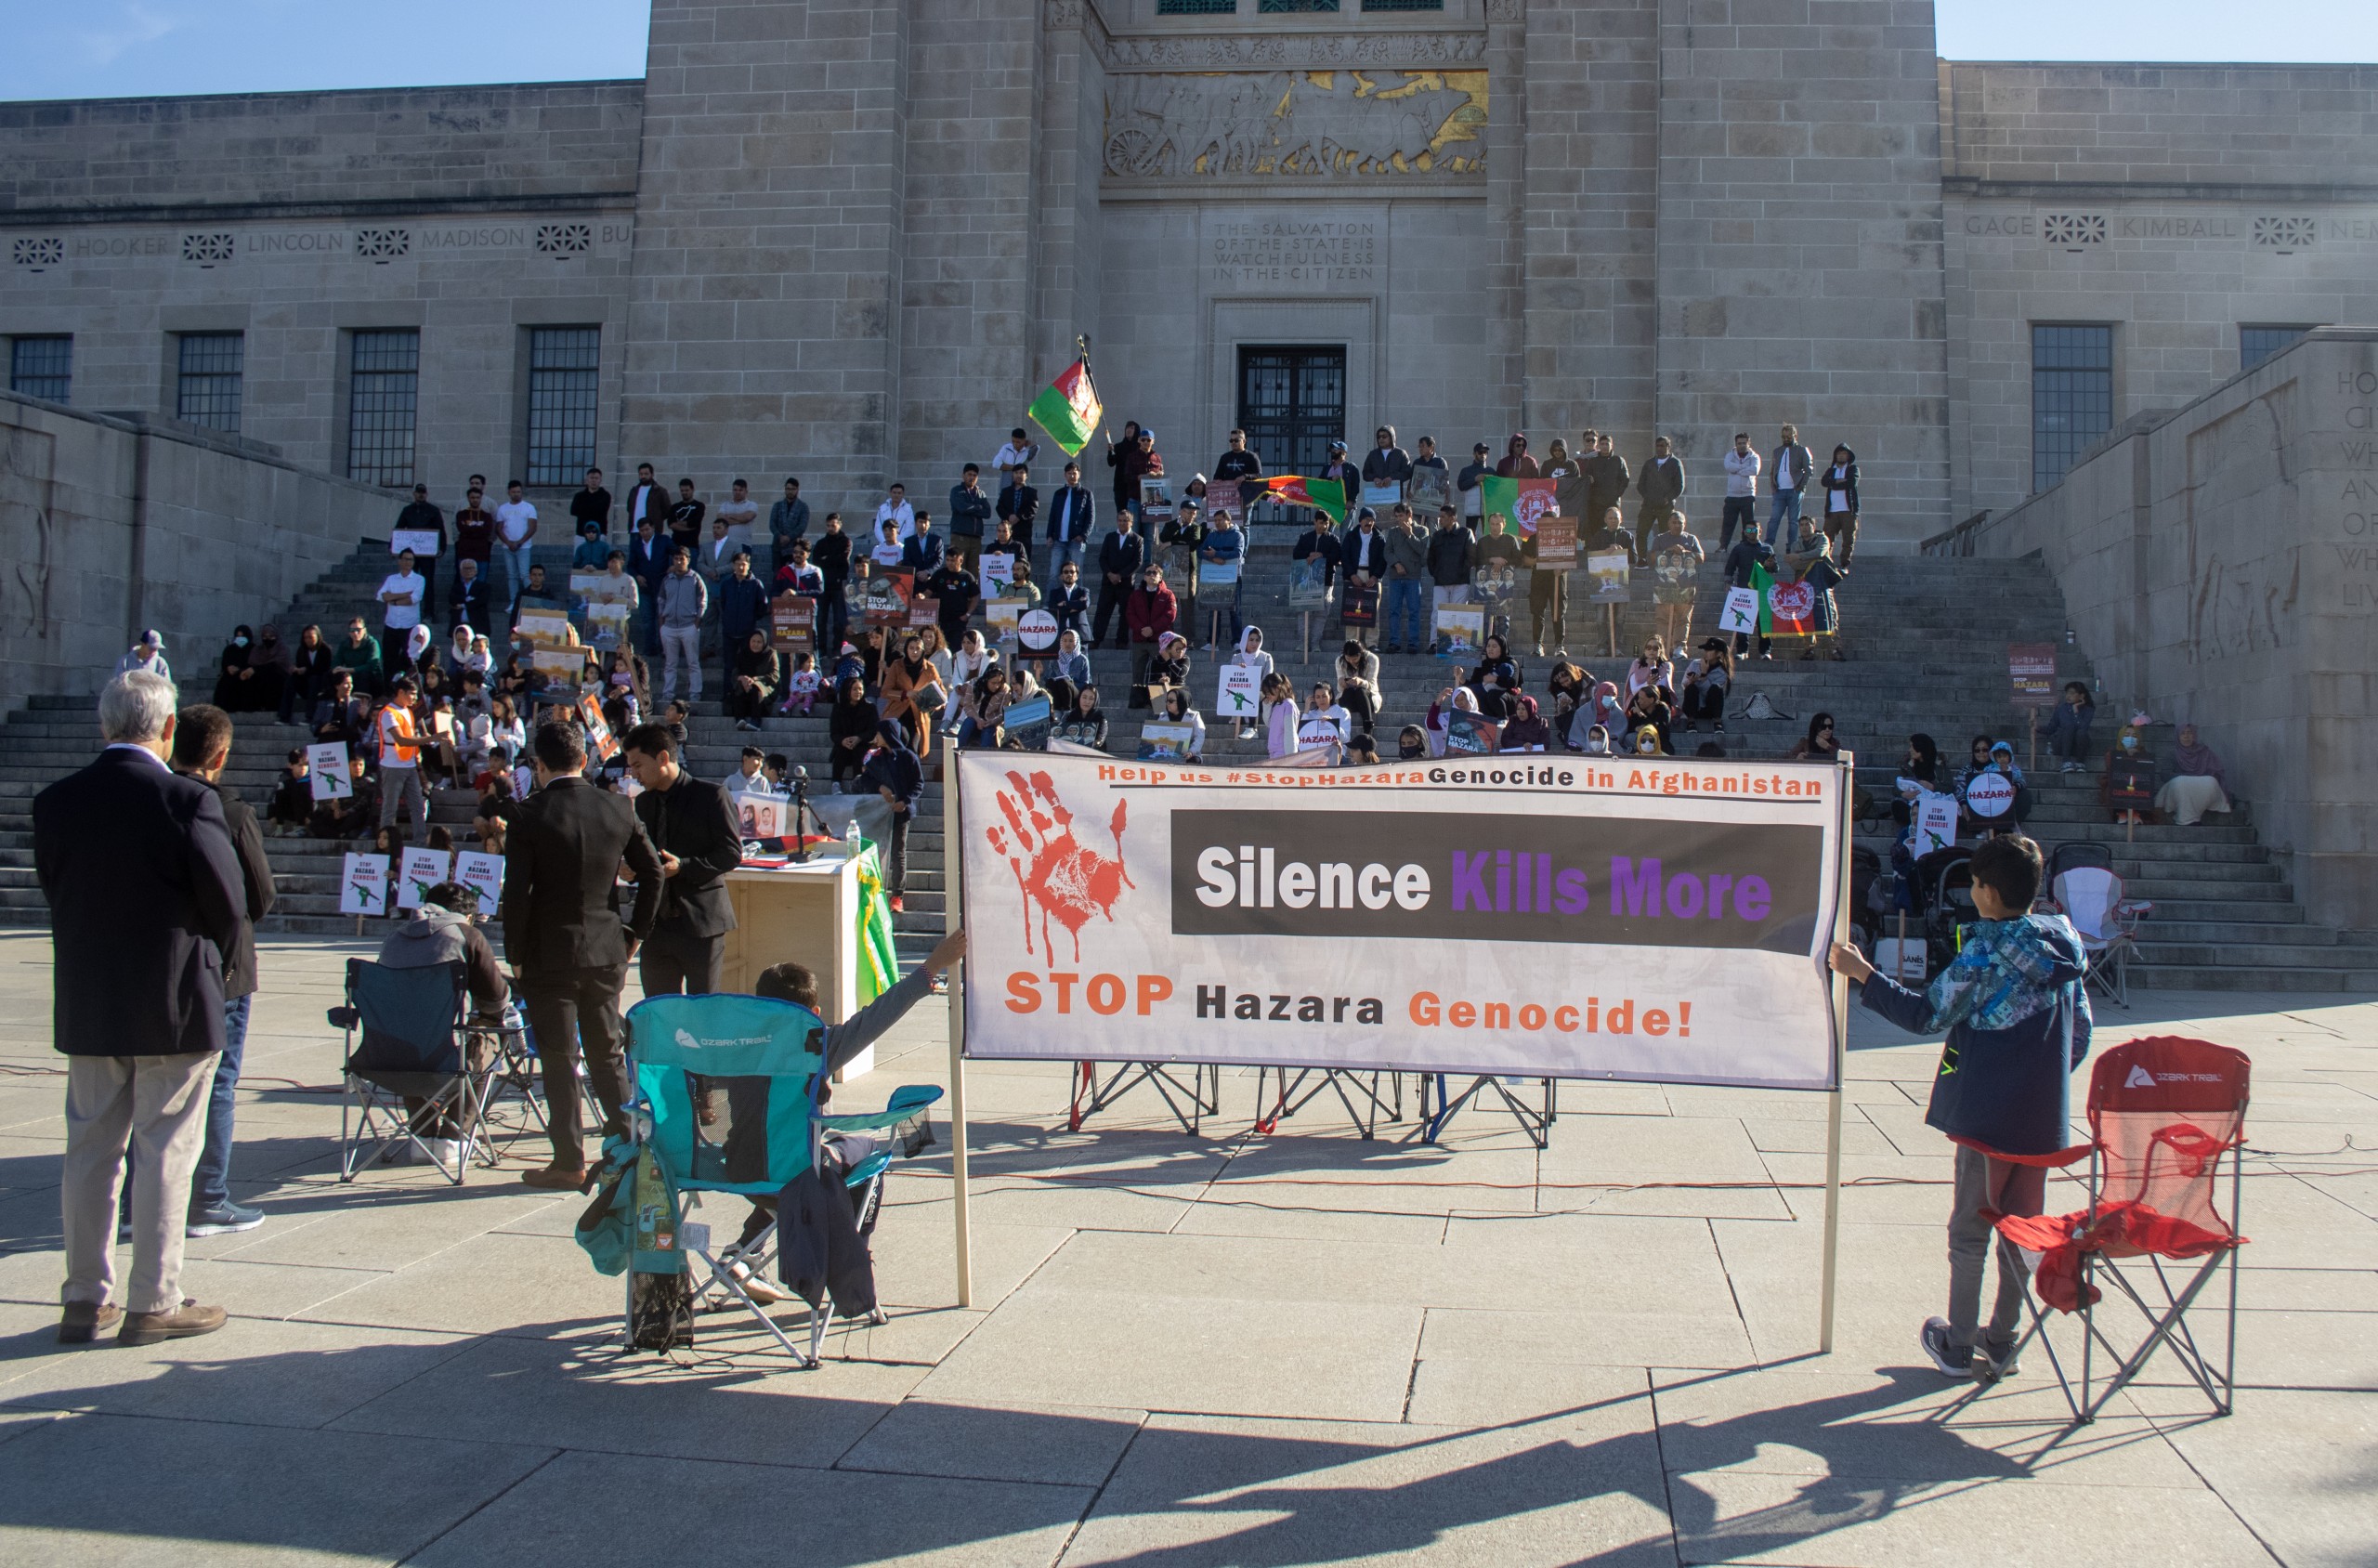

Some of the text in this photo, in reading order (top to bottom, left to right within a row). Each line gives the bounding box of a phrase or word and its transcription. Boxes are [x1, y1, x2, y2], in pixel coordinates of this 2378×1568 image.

[1214, 223, 1374, 235] THE SALVATION
[1966, 216, 2033, 235] GAGE
[2123, 217, 2237, 237] KIMBALL
[248, 233, 343, 252] LINCOLN
[422, 229, 524, 249] MADISON
[1214, 238, 1374, 250] OF THE STATE IS
[76, 237, 168, 256] HOOKER
[1214, 253, 1374, 265] WATCHFULNESS
[1212, 268, 1373, 280] IN THE CITIZEN
[867, 602, 896, 611] HAZARA
[1019, 625, 1057, 634] HAZARA
[1299, 735, 1338, 744] HAZARA
[1448, 735, 1469, 745] STOP
[1447, 740, 1479, 753] HAZARA
[1099, 764, 1167, 785] Help
[1181, 772, 1213, 783] us
[1587, 767, 1614, 789] in
[1627, 769, 1822, 796] Afghanistan
[1968, 790, 2012, 800] HAZARA
[1196, 845, 1772, 921] Silence Kills More
[1005, 972, 1692, 1037] STOP Hazara Genocide!
